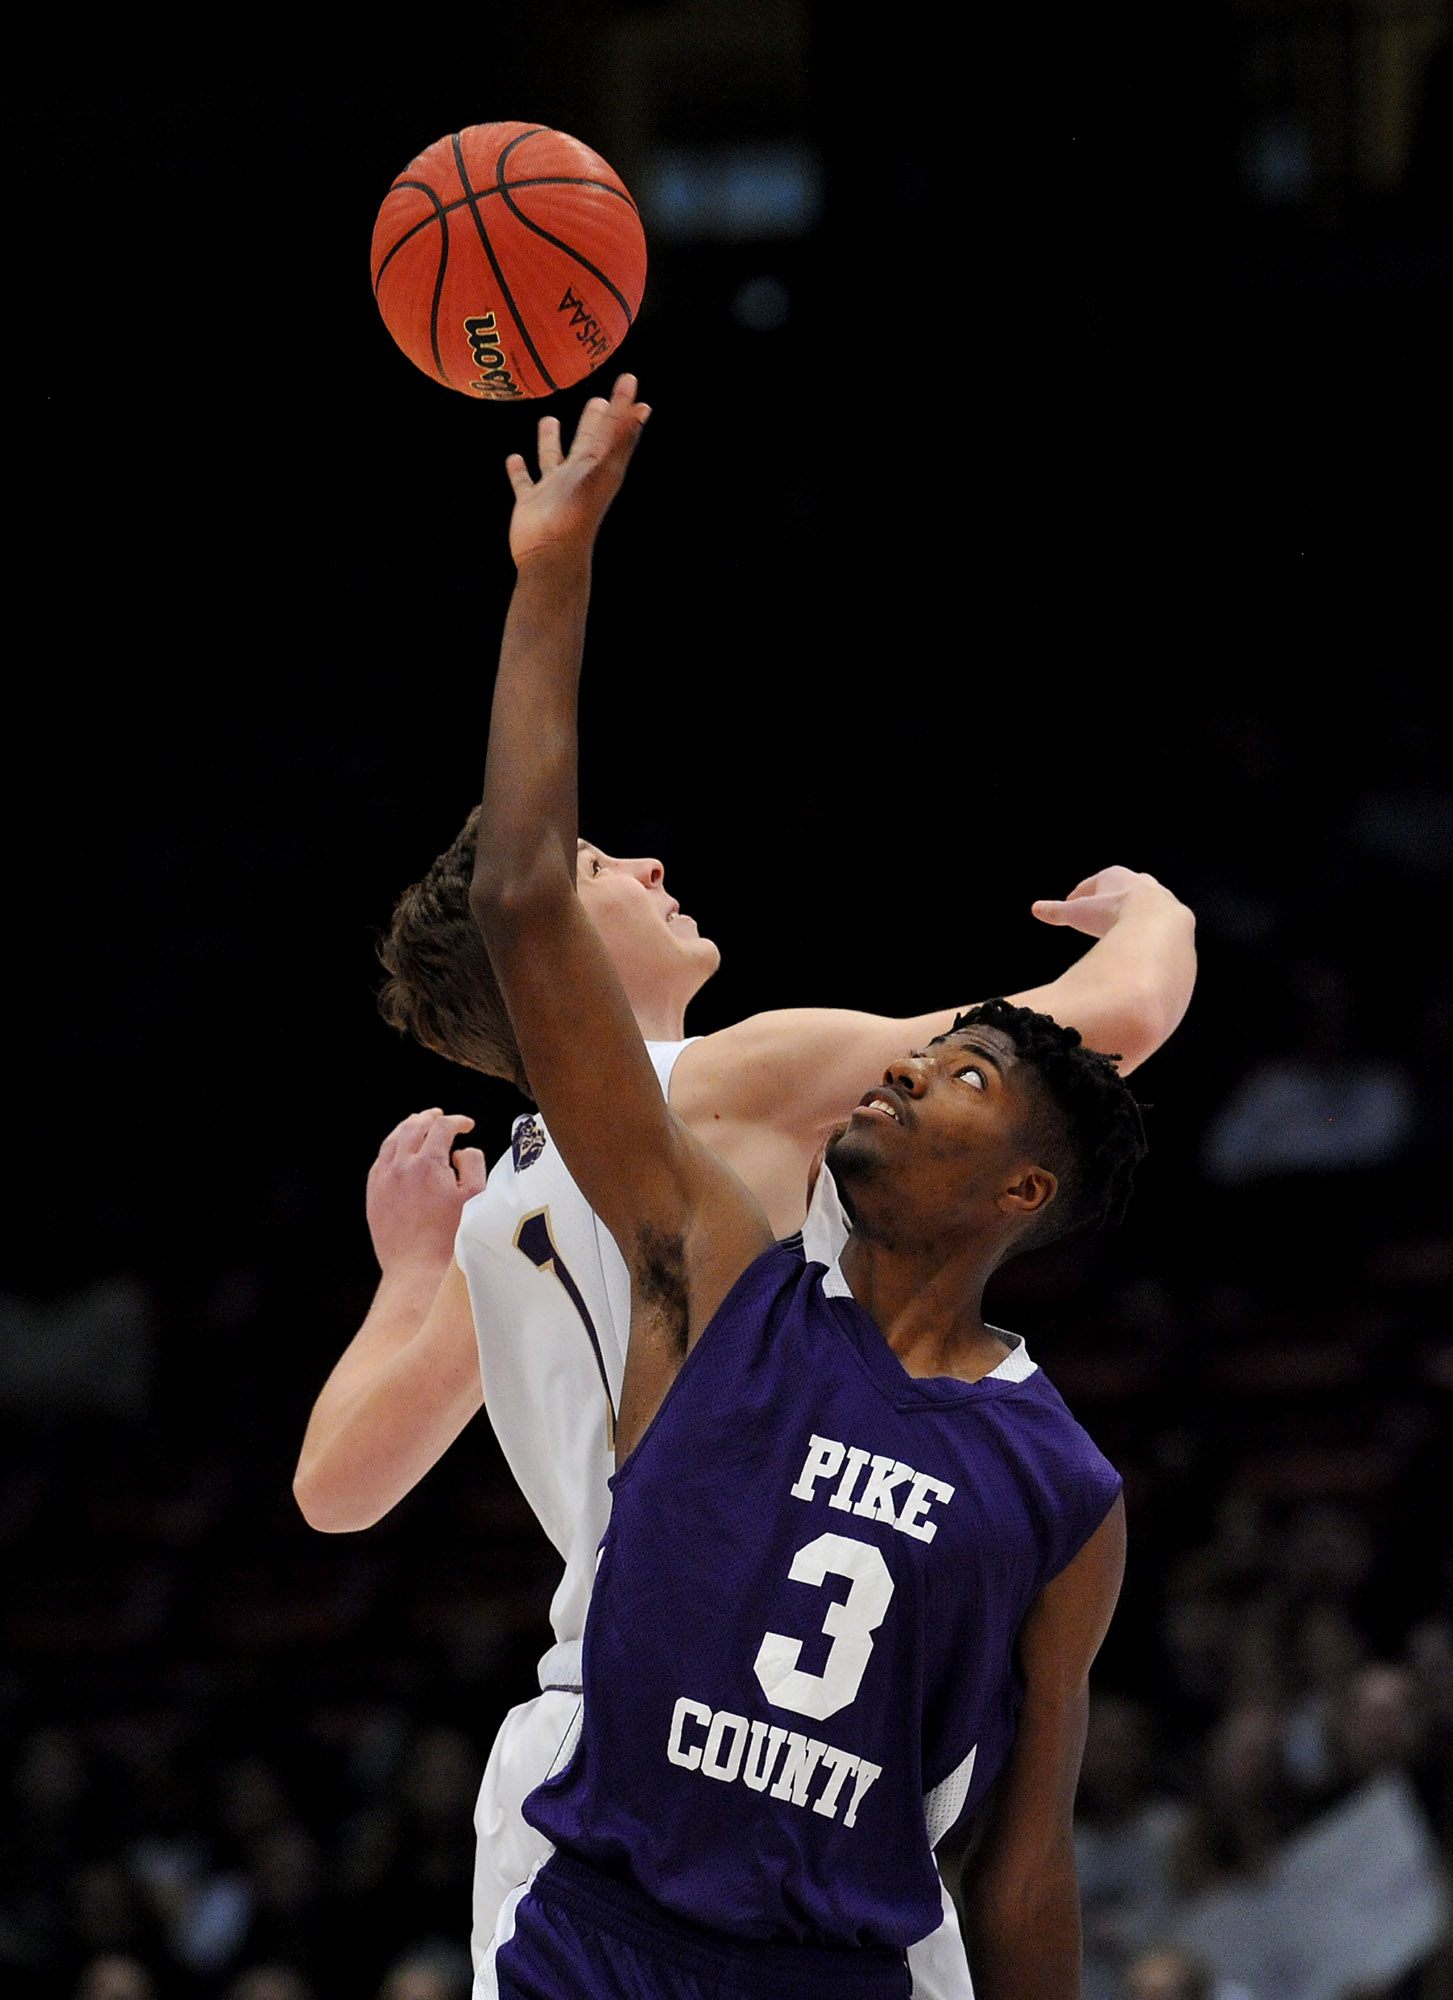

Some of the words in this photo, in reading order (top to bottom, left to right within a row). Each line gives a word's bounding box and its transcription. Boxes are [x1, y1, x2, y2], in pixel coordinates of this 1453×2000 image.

[463, 311, 524, 398] lson
[791, 1434, 955, 1544] PIKE
[753, 1532, 895, 1721] 3
[667, 1697, 882, 1828] COUNTY
